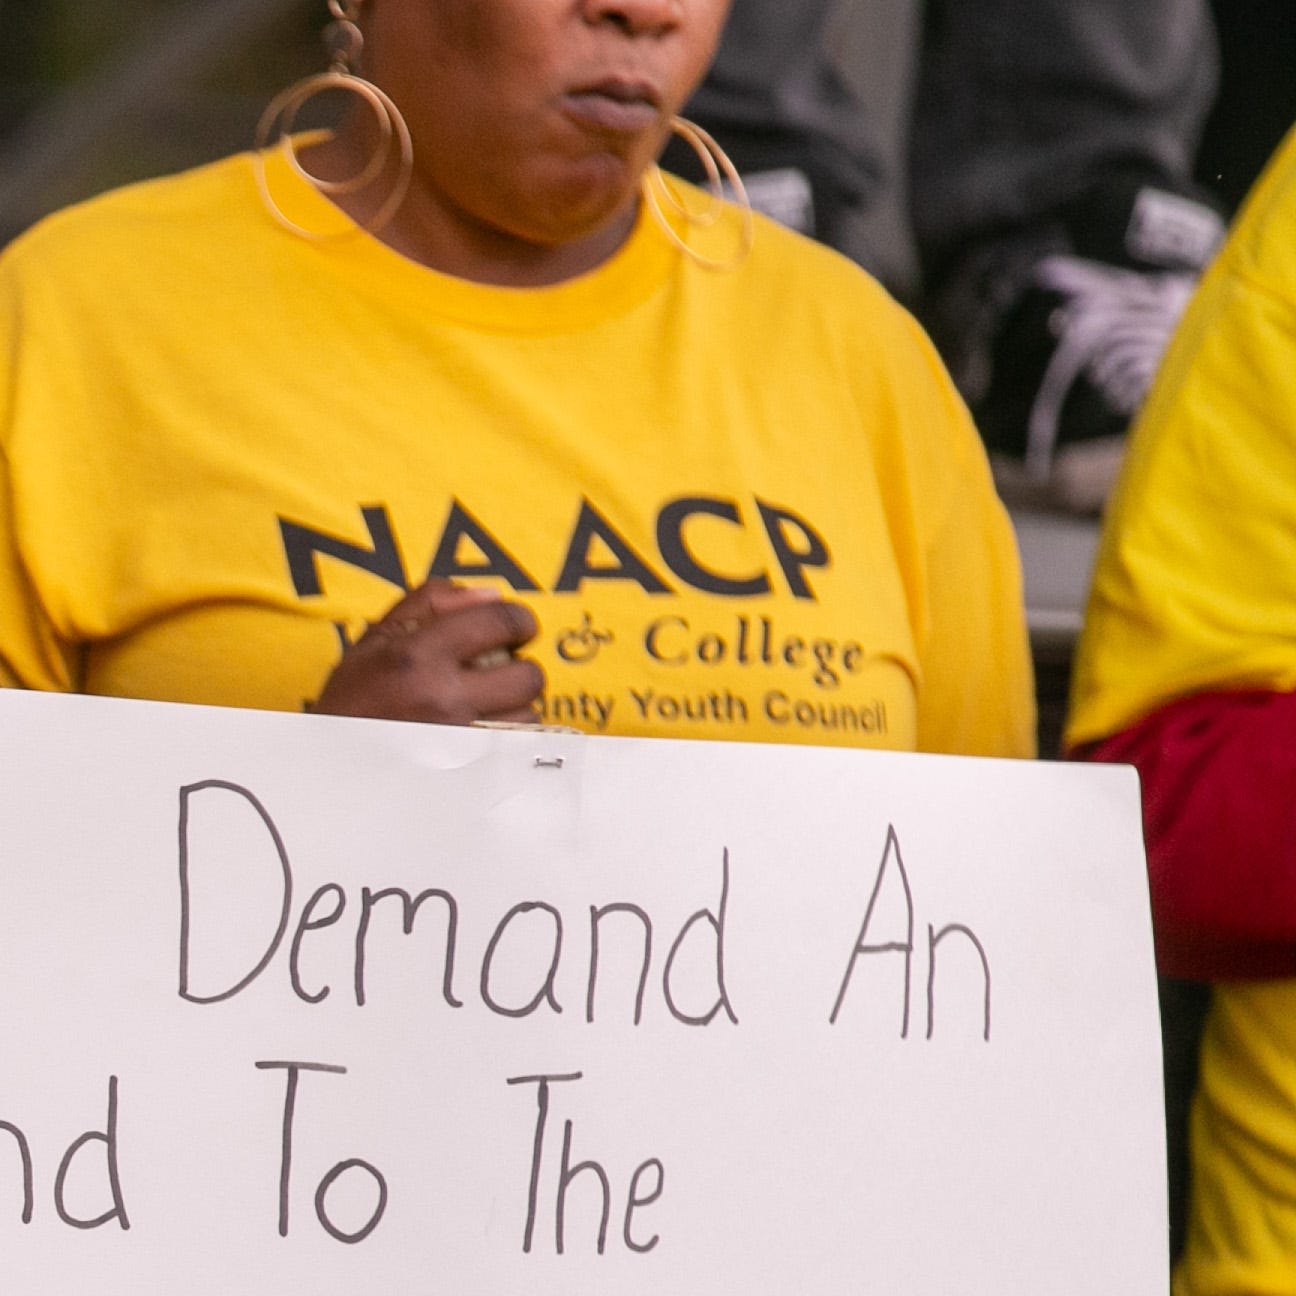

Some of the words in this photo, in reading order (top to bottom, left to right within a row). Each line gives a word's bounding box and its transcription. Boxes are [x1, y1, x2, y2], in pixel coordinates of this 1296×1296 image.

[276, 494, 831, 600] NAACP
[556, 611, 614, 664] &
[644, 616, 864, 689] College
[627, 688, 749, 724] Youth
[763, 690, 888, 735] Council
[177, 780, 740, 1027] Demand
[828, 823, 991, 1043] An
[254, 1060, 388, 1245] To
[505, 1070, 665, 1256] The
